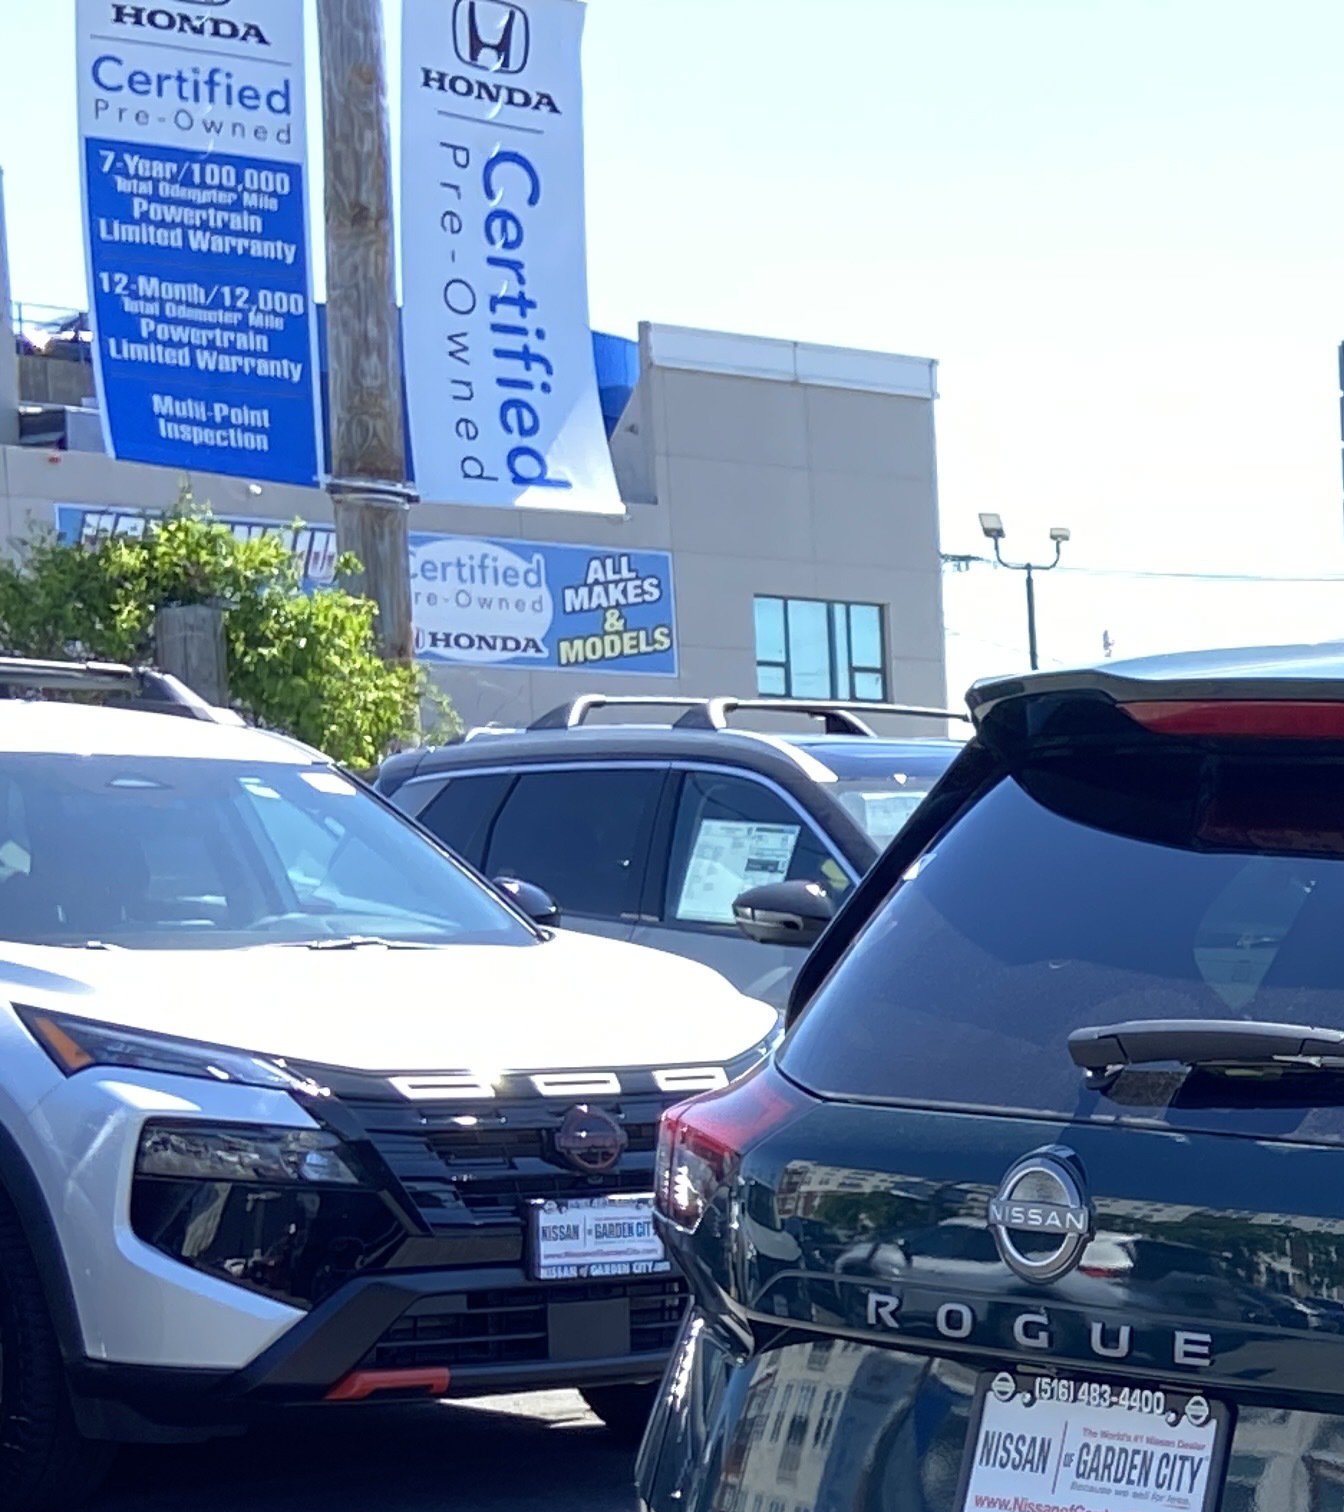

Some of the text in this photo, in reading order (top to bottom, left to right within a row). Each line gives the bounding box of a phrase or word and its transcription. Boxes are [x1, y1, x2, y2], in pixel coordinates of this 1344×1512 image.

[111, 4, 271, 46] HONDA
[91, 55, 292, 116] Certified
[420, 67, 562, 115] HONDA
[94, 98, 292, 145] Pre-Owned
[98, 149, 290, 195] 7-Year/100,000
[114, 174, 153, 195] Total
[242, 192, 279, 212] Mile
[132, 197, 263, 234] Powertrain
[99, 217, 297, 265] Limited Warranty
[99, 271, 305, 316] 12-Month/12,000
[439, 141, 499, 482] Pre-Owned
[140, 317, 269, 352] Powertrain
[483, 150, 573, 489] Certified
[108, 337, 303, 384] Limited Warranty
[152, 393, 270, 428] Multi-Point
[158, 417, 269, 452] Inspection
[586, 554, 637, 585] ALL
[414, 589, 544, 613] re-Owned
[562, 578, 662, 613] MAKES
[603, 608, 625, 631] &
[429, 631, 544, 654] HONDA
[558, 626, 671, 666] MODELS
[541, 1224, 580, 1241] NISSAN
[990, 1203, 1088, 1232] NISSAN
[866, 1293, 1214, 1367] ROGUE
[1034, 1377, 1166, 1415] (516) 483-4400
[978, 1430, 1052, 1475] NISSAN
[1075, 1441, 1154, 1488] GARDEN
[1154, 1452, 1204, 1494] CITY
